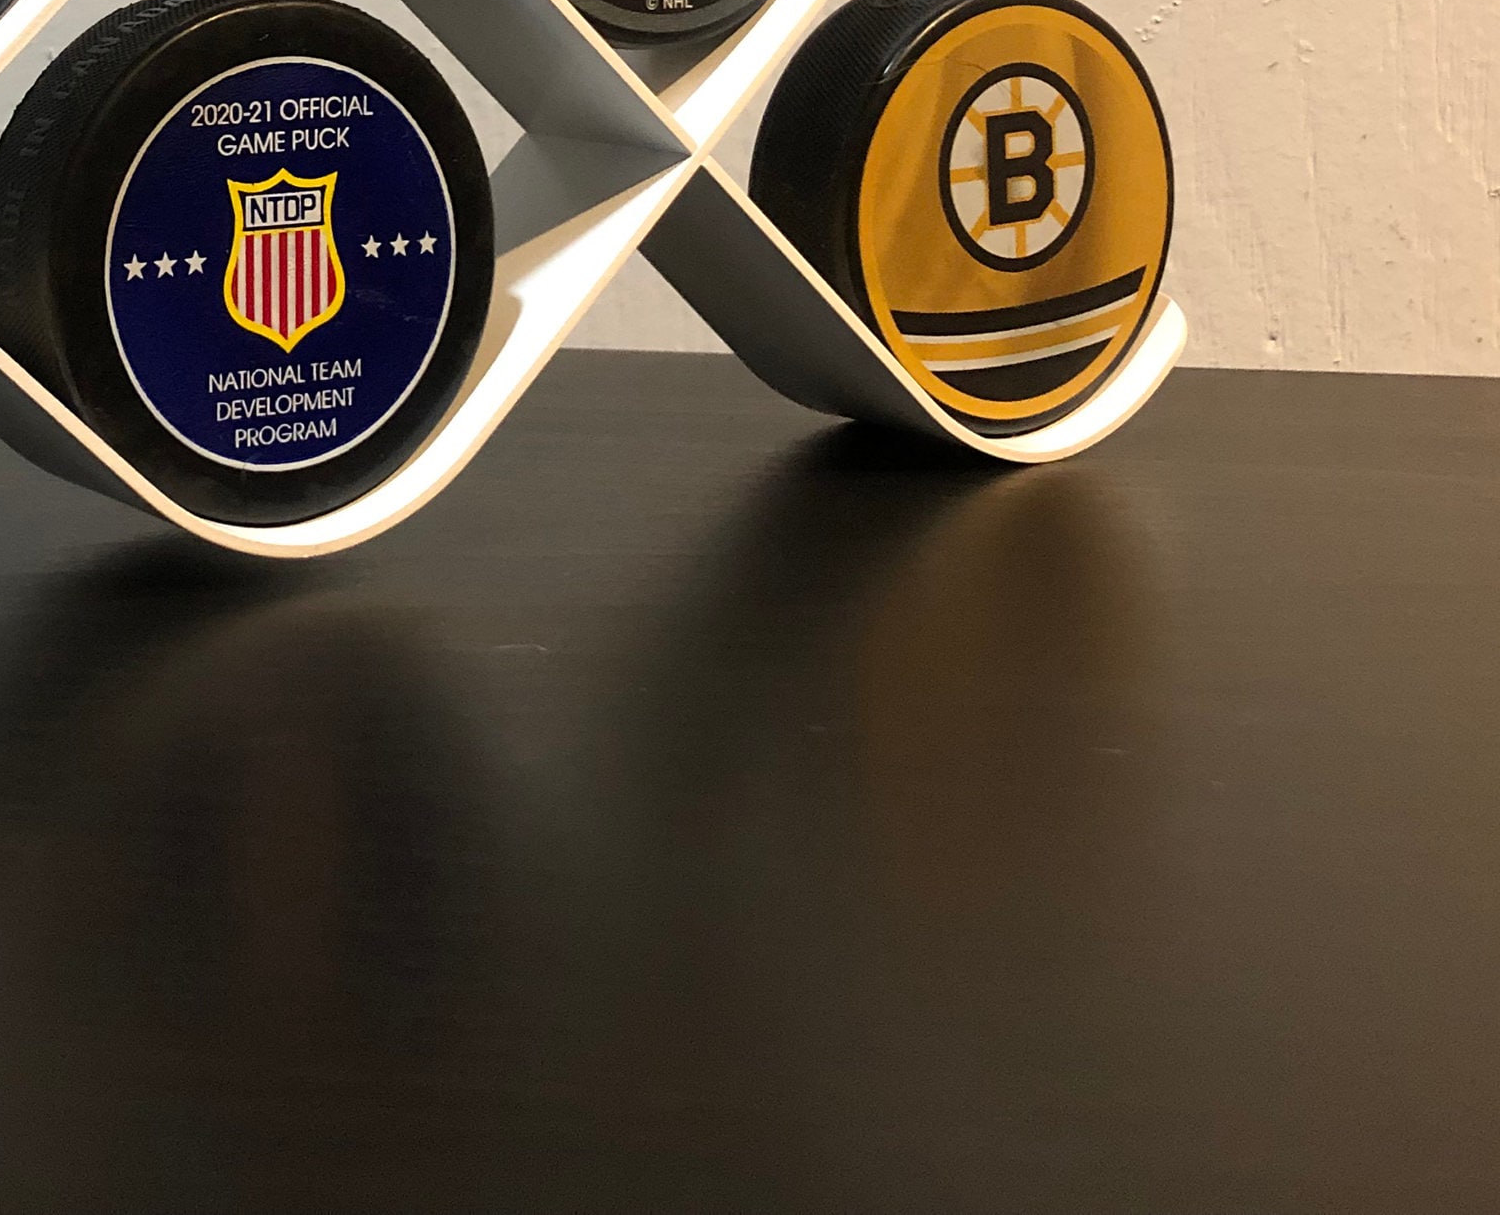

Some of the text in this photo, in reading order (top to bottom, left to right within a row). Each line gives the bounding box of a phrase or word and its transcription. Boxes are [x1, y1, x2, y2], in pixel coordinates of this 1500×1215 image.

[191, 95, 374, 127] 2020-21 OFFICIAL
[217, 126, 350, 156] GAME PUCK
[985, 110, 1054, 226] B
[250, 193, 316, 225] NTDP
[208, 358, 362, 393] NATIONAL TEAM
[216, 387, 356, 421] DEVELOPMENT
[234, 417, 337, 448] PROGRAM
